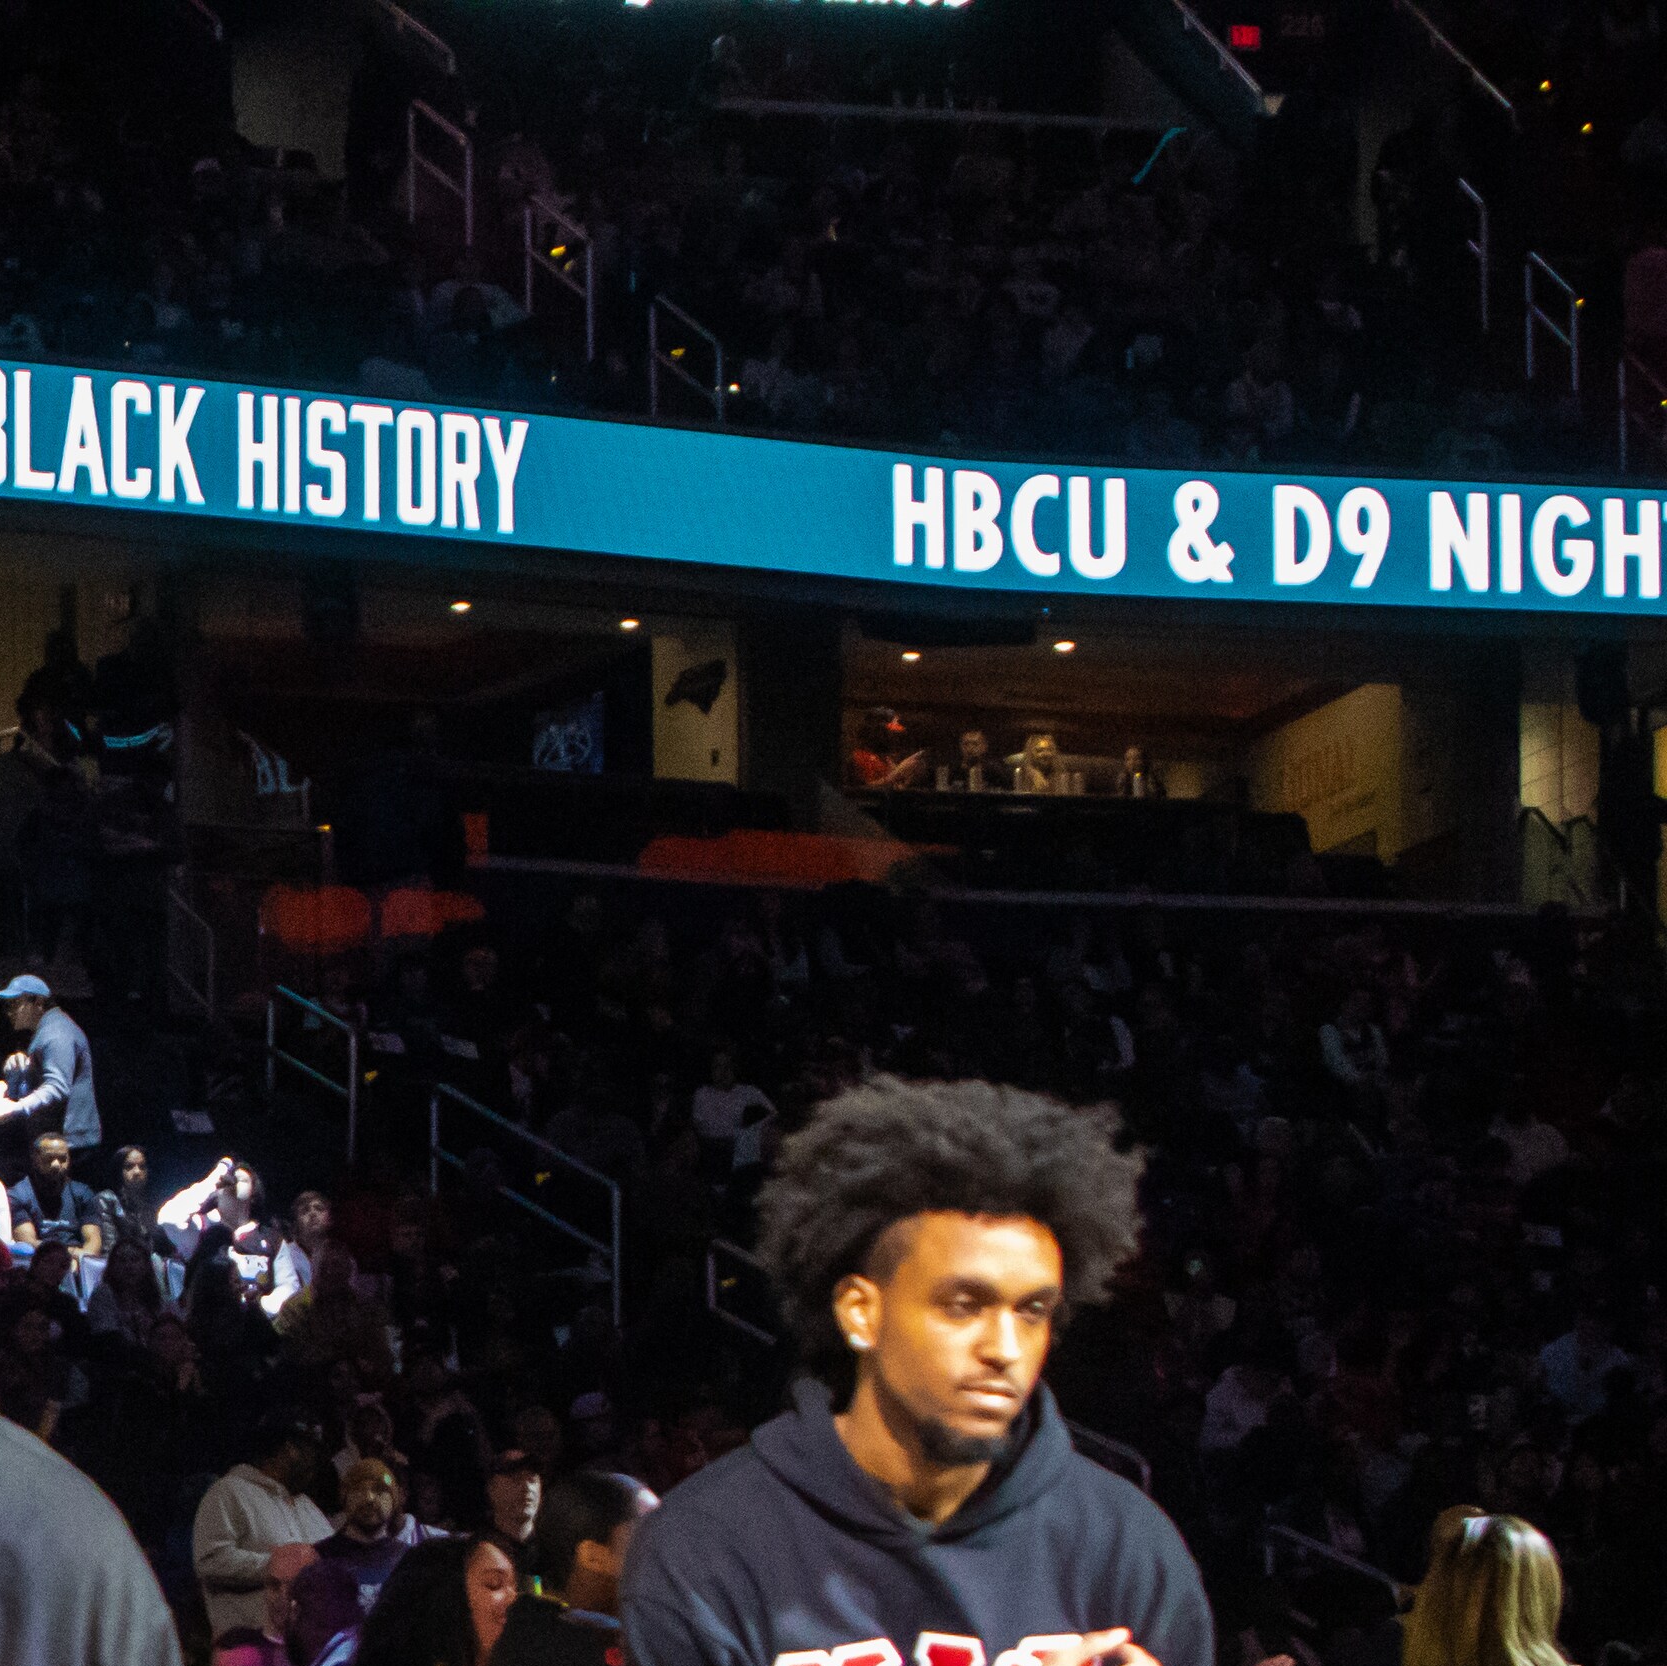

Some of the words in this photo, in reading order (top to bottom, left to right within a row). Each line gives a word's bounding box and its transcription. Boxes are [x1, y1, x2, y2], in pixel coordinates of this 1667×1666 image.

[237, 390, 530, 535] HISTORY
[893, 463, 1127, 579] HBCU
[1167, 480, 1235, 584] &
[1272, 484, 1390, 589] D9
[1429, 491, 1667, 599] NIGH
